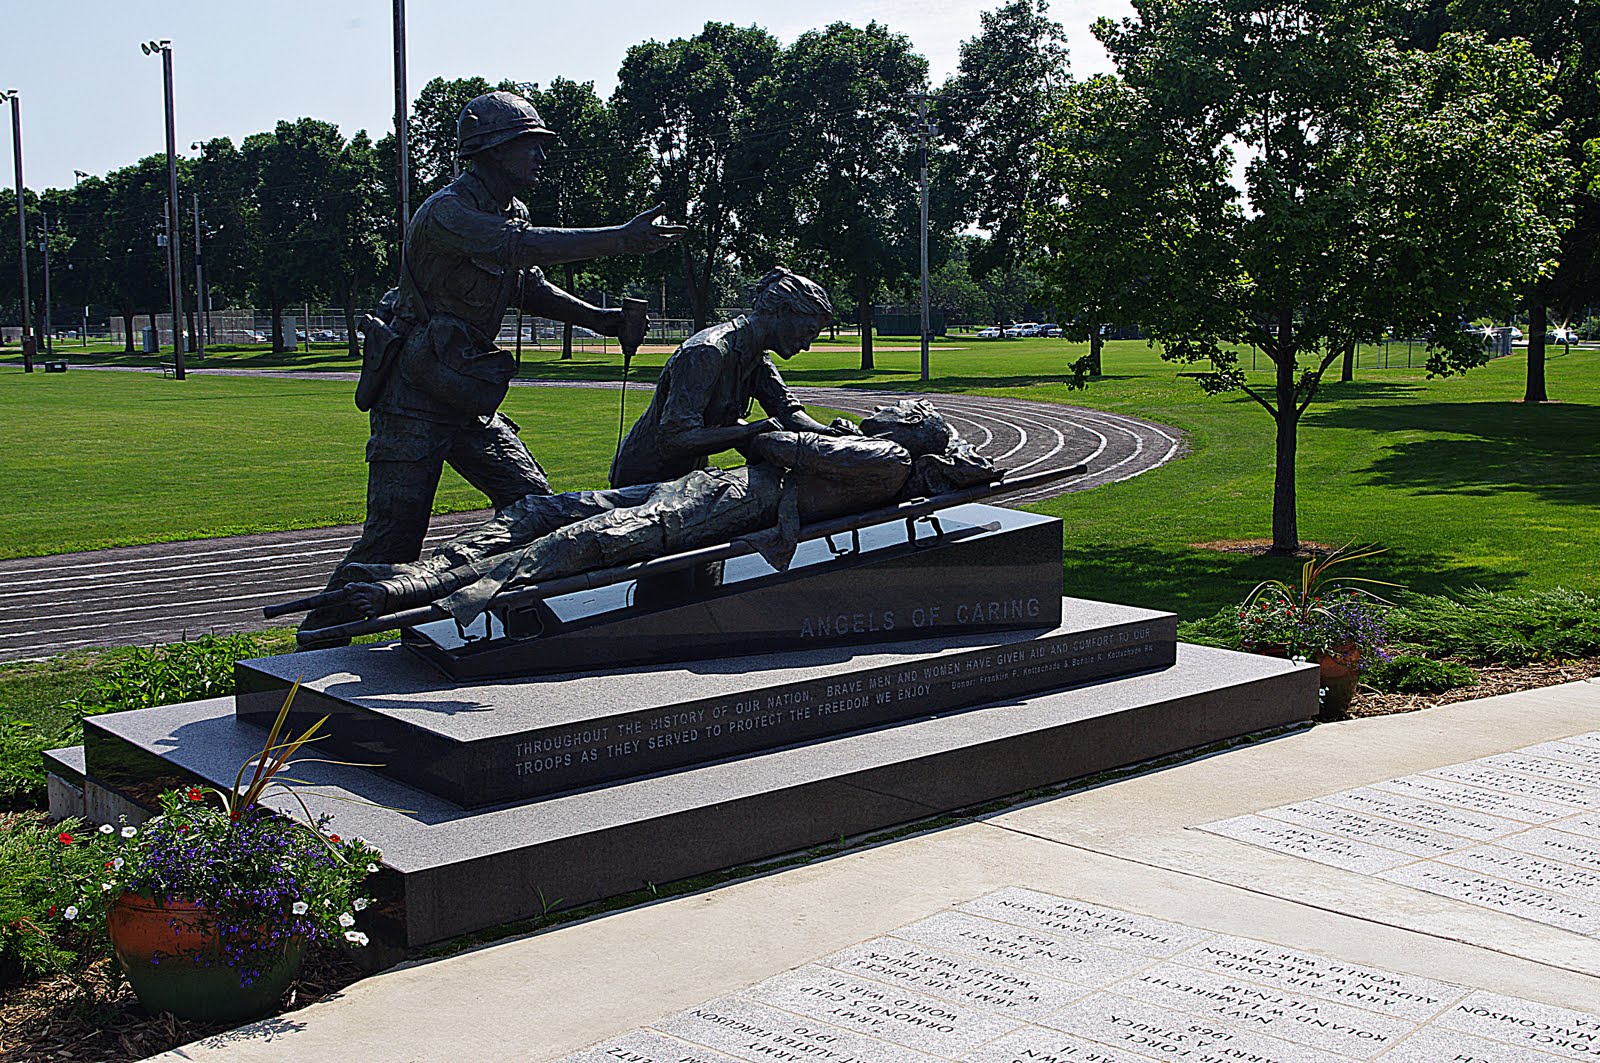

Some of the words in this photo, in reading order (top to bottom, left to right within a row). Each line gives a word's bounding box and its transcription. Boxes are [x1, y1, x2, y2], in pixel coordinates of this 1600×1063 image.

[800, 611, 895, 637] ANGELS
[912, 607, 940, 627] OF
[956, 598, 1040, 624] CARING
[952, 680, 976, 690] Donor:
[980, 673, 1008, 683] Franklin
[515, 728, 608, 756] THROUGHOUT
[618, 722, 642, 736] THE
[651, 710, 704, 730] HISTORY
[713, 706, 728, 718] OF
[736, 701, 760, 714] OUR
[827, 681, 862, 697] BRAVE
[869, 676, 891, 689] MEN
[898, 671, 917, 685] AND
[924, 662, 960, 678] WOMEN
[966, 657, 991, 671] HAVE
[997, 651, 1024, 664] GIVEN
[1030, 648, 1045, 658] AID
[1050, 643, 1068, 654] AND
[1073, 634, 1114, 651] COMFORT
[1119, 632, 1129, 642] TO
[1134, 628, 1150, 639] OUR
[516, 754, 571, 776] TROOPS
[580, 748, 598, 764] AS
[607, 740, 640, 757] THEY
[649, 730, 698, 749] SERVED
[706, 725, 721, 738] TO
[729, 712, 782, 733] PROTECT
[790, 708, 810, 720] THE
[818, 696, 869, 718] FREEDOM
[876, 692, 891, 704] WE
[898, 684, 931, 700] ENJOY
[1344, 815, 1370, 823] WAR
[1286, 830, 1351, 849] VIETNAM
[1333, 826, 1371, 836] ARMY
[1379, 824, 1428, 838] WORLD
[1270, 841, 1309, 852] NAVY
[1384, 832, 1453, 850] RICHARD
[1317, 845, 1361, 858] JAMES
[1531, 861, 1562, 871] WAR
[1526, 875, 1567, 888] NAVY
[1555, 876, 1593, 887] PAUL
[1473, 879, 1552, 902] VIETNAM
[1465, 893, 1509, 906] NAVY
[1493, 894, 1586, 918] MATTHEW
[999, 901, 1069, 919] DAWSON
[1056, 905, 1133, 925] VIETNAM
[1041, 921, 1092, 934] ARMY
[1092, 923, 1168, 943] THOMAS
[977, 947, 1028, 960] ARMY
[1035, 949, 1082, 963] GENE
[1278, 955, 1315, 966] WAR
[853, 961, 920, 981] FORCES
[865, 953, 933, 972] STRUCK
[925, 957, 958, 969] WAR
[1202, 948, 1325, 978] MALCOMSON
[1216, 960, 1277, 977] CORPS
[925, 980, 957, 990] AIR
[937, 972, 1014, 995] WILLIAM
[969, 968, 1030, 988] WORLD
[1287, 978, 1323, 988] AIR
[1329, 967, 1400, 986] WORLD
[800, 987, 845, 1001] CULP
[850, 987, 884, 1000] WAR
[961, 991, 1019, 1007] ARMY
[1139, 976, 1260, 1009] LAMBRECHT
[1223, 986, 1318, 1014] VIETNAM
[1336, 989, 1395, 1005] ARMY
[1356, 983, 1438, 1003] ALDEAN
[828, 1009, 884, 1025] ARMY
[894, 1000, 957, 1021] WORLD
[1213, 1007, 1273, 1024] NAVY
[1266, 1008, 1284, 1016] W
[690, 1010, 772, 1037] FERGUSON
[867, 1006, 954, 1033] ORMOND
[1457, 1006, 1597, 1043] MALCOMSON
[793, 1028, 837, 1043] 1970
[1105, 1016, 1188, 1041] STRUCK
[1188, 1026, 1233, 1040] 1968
[1296, 1016, 1387, 1042] ROLAND
[744, 1043, 802, 1061] ARMY
[773, 1036, 839, 1058] ALISTER
[1060, 1046, 1078, 1055] II
[1119, 1033, 1191, 1056] FORCE
